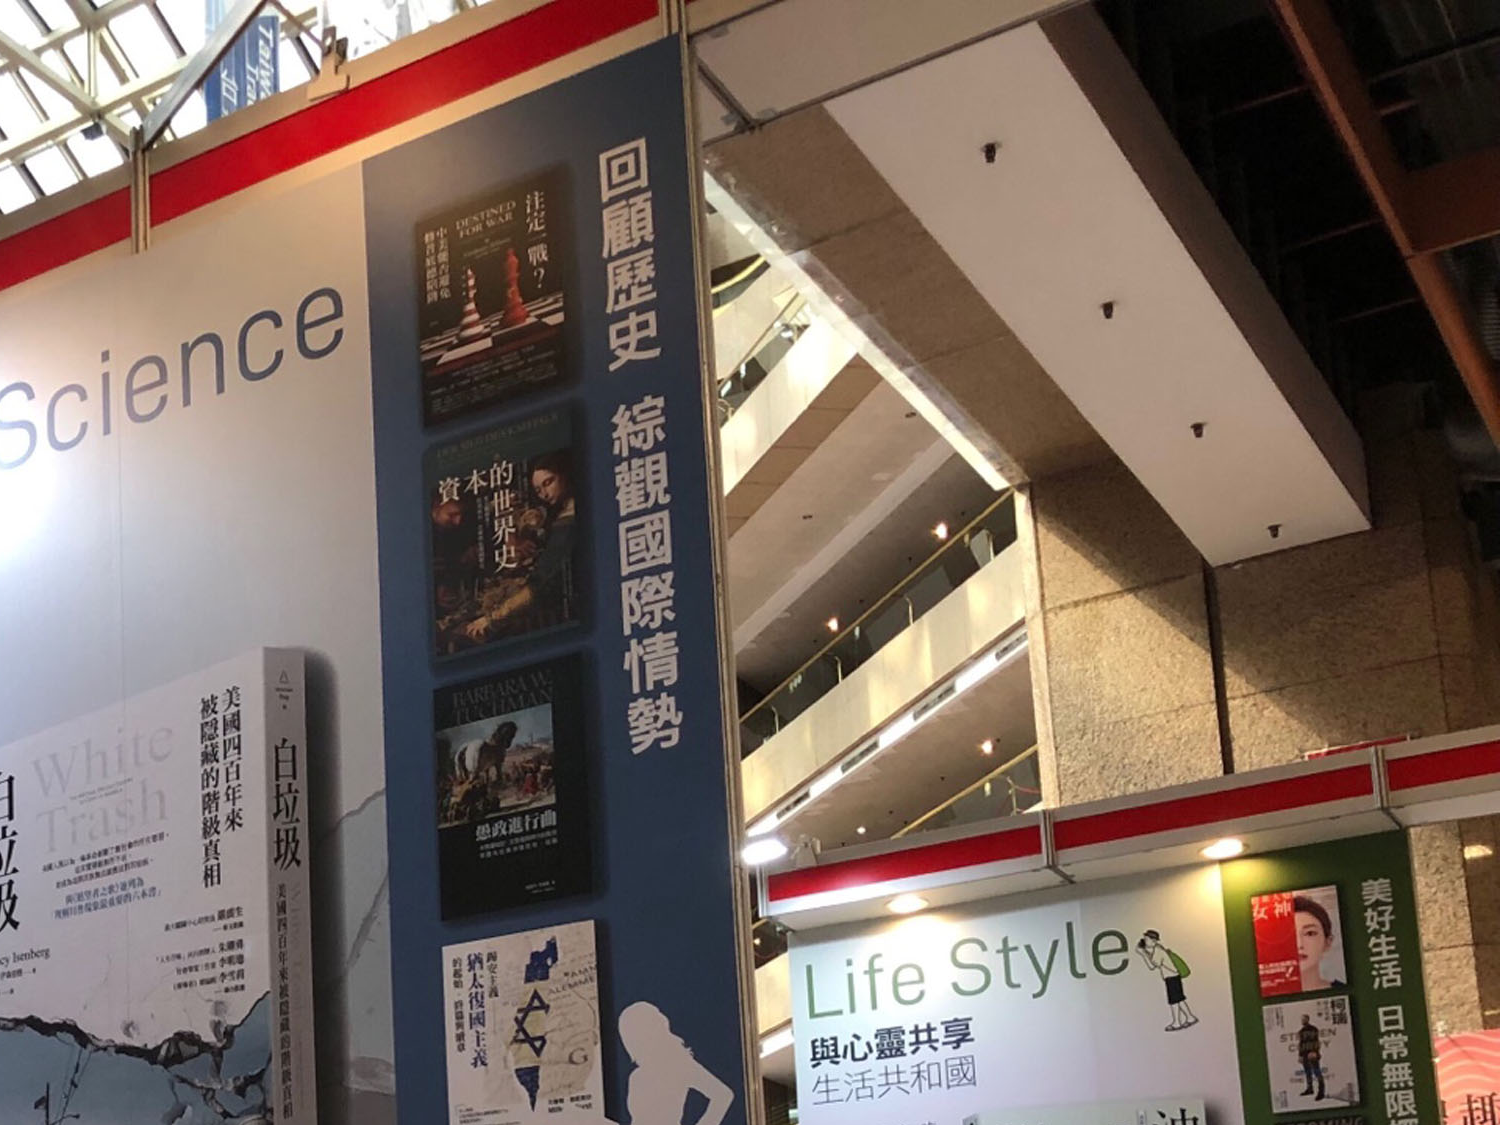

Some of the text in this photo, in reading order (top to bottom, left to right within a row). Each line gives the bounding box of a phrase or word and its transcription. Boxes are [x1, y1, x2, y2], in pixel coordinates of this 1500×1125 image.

[455, 199, 517, 231] DESTINED
[459, 211, 514, 240] FOR WAR
[598, 137, 683, 756] 回顧歷史 綜觀國際情勢
[31, 724, 175, 799] White
[199, 693, 222, 889] 被隱藏的階級真相
[222, 685, 244, 833] 美國四百年來
[35, 776, 169, 855] Trash
[272, 736, 302, 872] 白垃圾
[475, 808, 557, 842] 愚政進行曲
[12, 947, 51, 963] Isenberg
[804, 920, 1131, 1021] Life Style
[1360, 877, 1403, 990] 美好生活
[466, 952, 488, 1069] 猶太復國主義
[809, 1016, 976, 1070] 與心靈共享
[810, 1055, 978, 1107] 生活共和國
